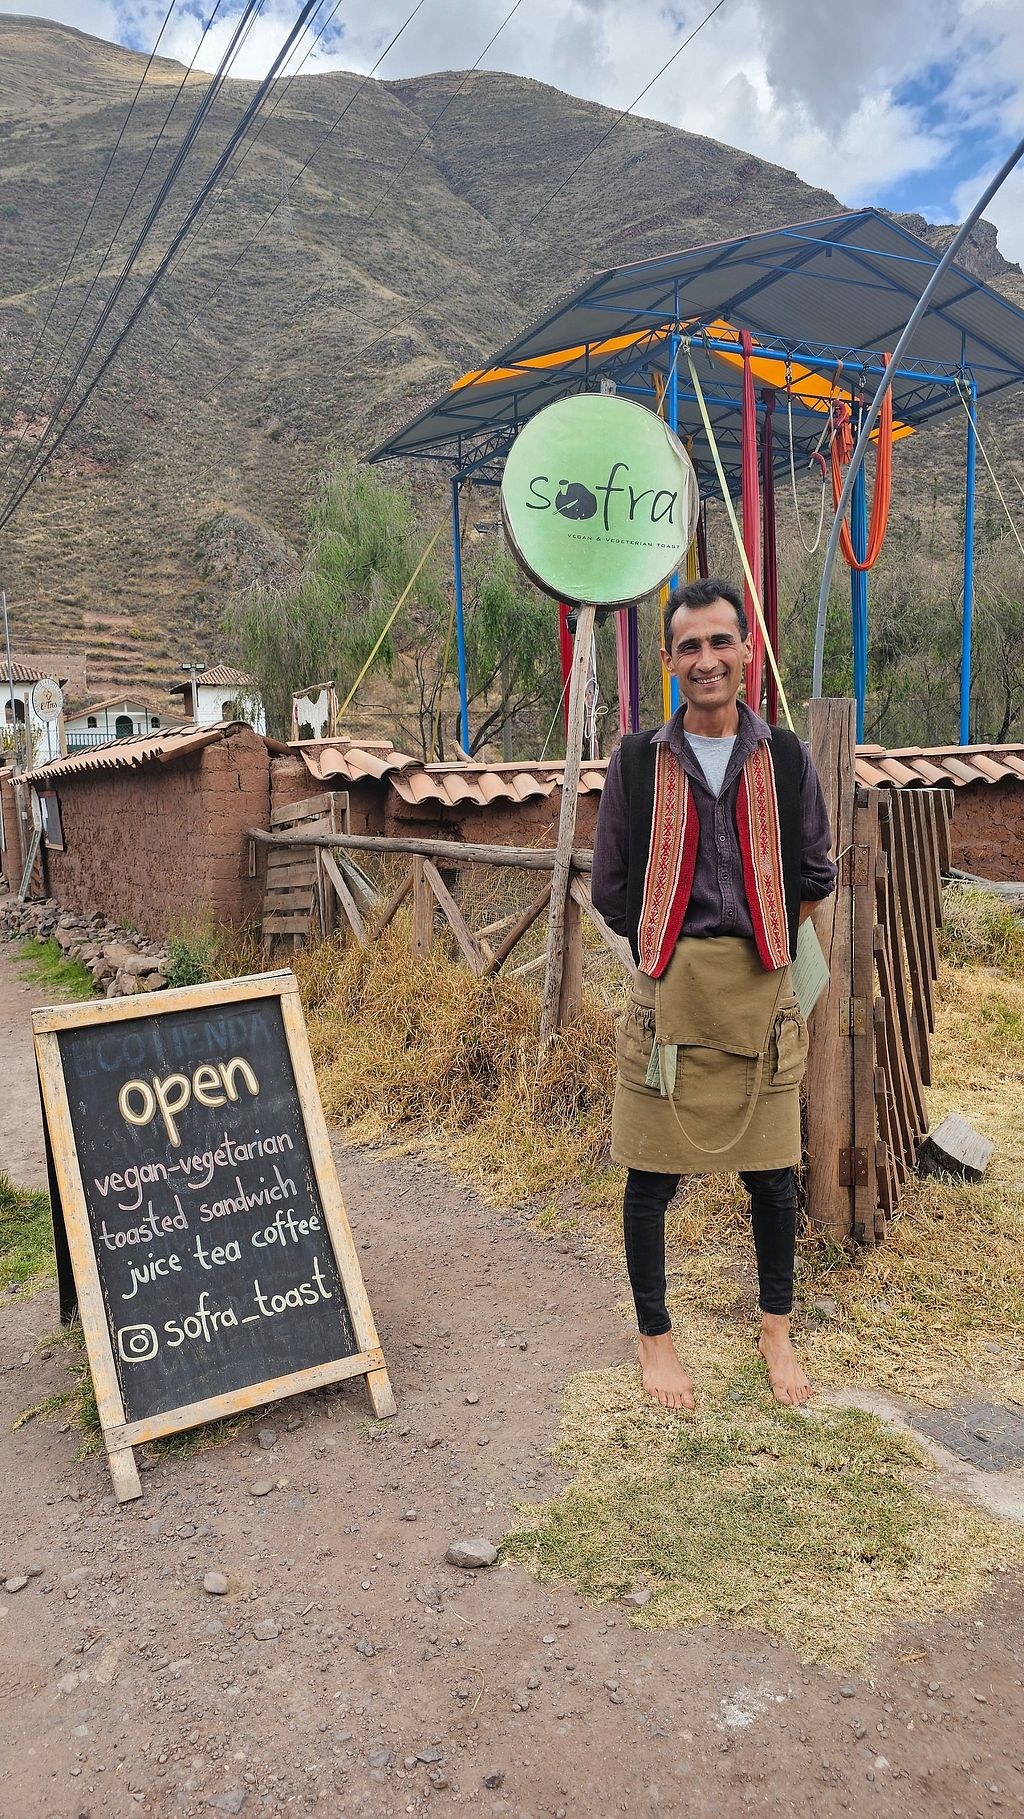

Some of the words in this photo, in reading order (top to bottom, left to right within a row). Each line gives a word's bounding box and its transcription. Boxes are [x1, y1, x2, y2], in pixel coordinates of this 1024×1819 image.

[525, 462, 678, 531] sofra
[567, 533, 592, 541] VEGAN
[605, 537, 653, 547] VEGETERIAN
[118, 1056, 260, 1149] open
[94, 1129, 294, 1212] vegan-vegetarian
[99, 1194, 189, 1251] toasted
[200, 1164, 298, 1223] sandwich
[121, 1252, 183, 1300] juice
[193, 1234, 242, 1270] tea
[251, 1208, 321, 1248] coffee
[163, 1256, 333, 1347] sofra_toast
